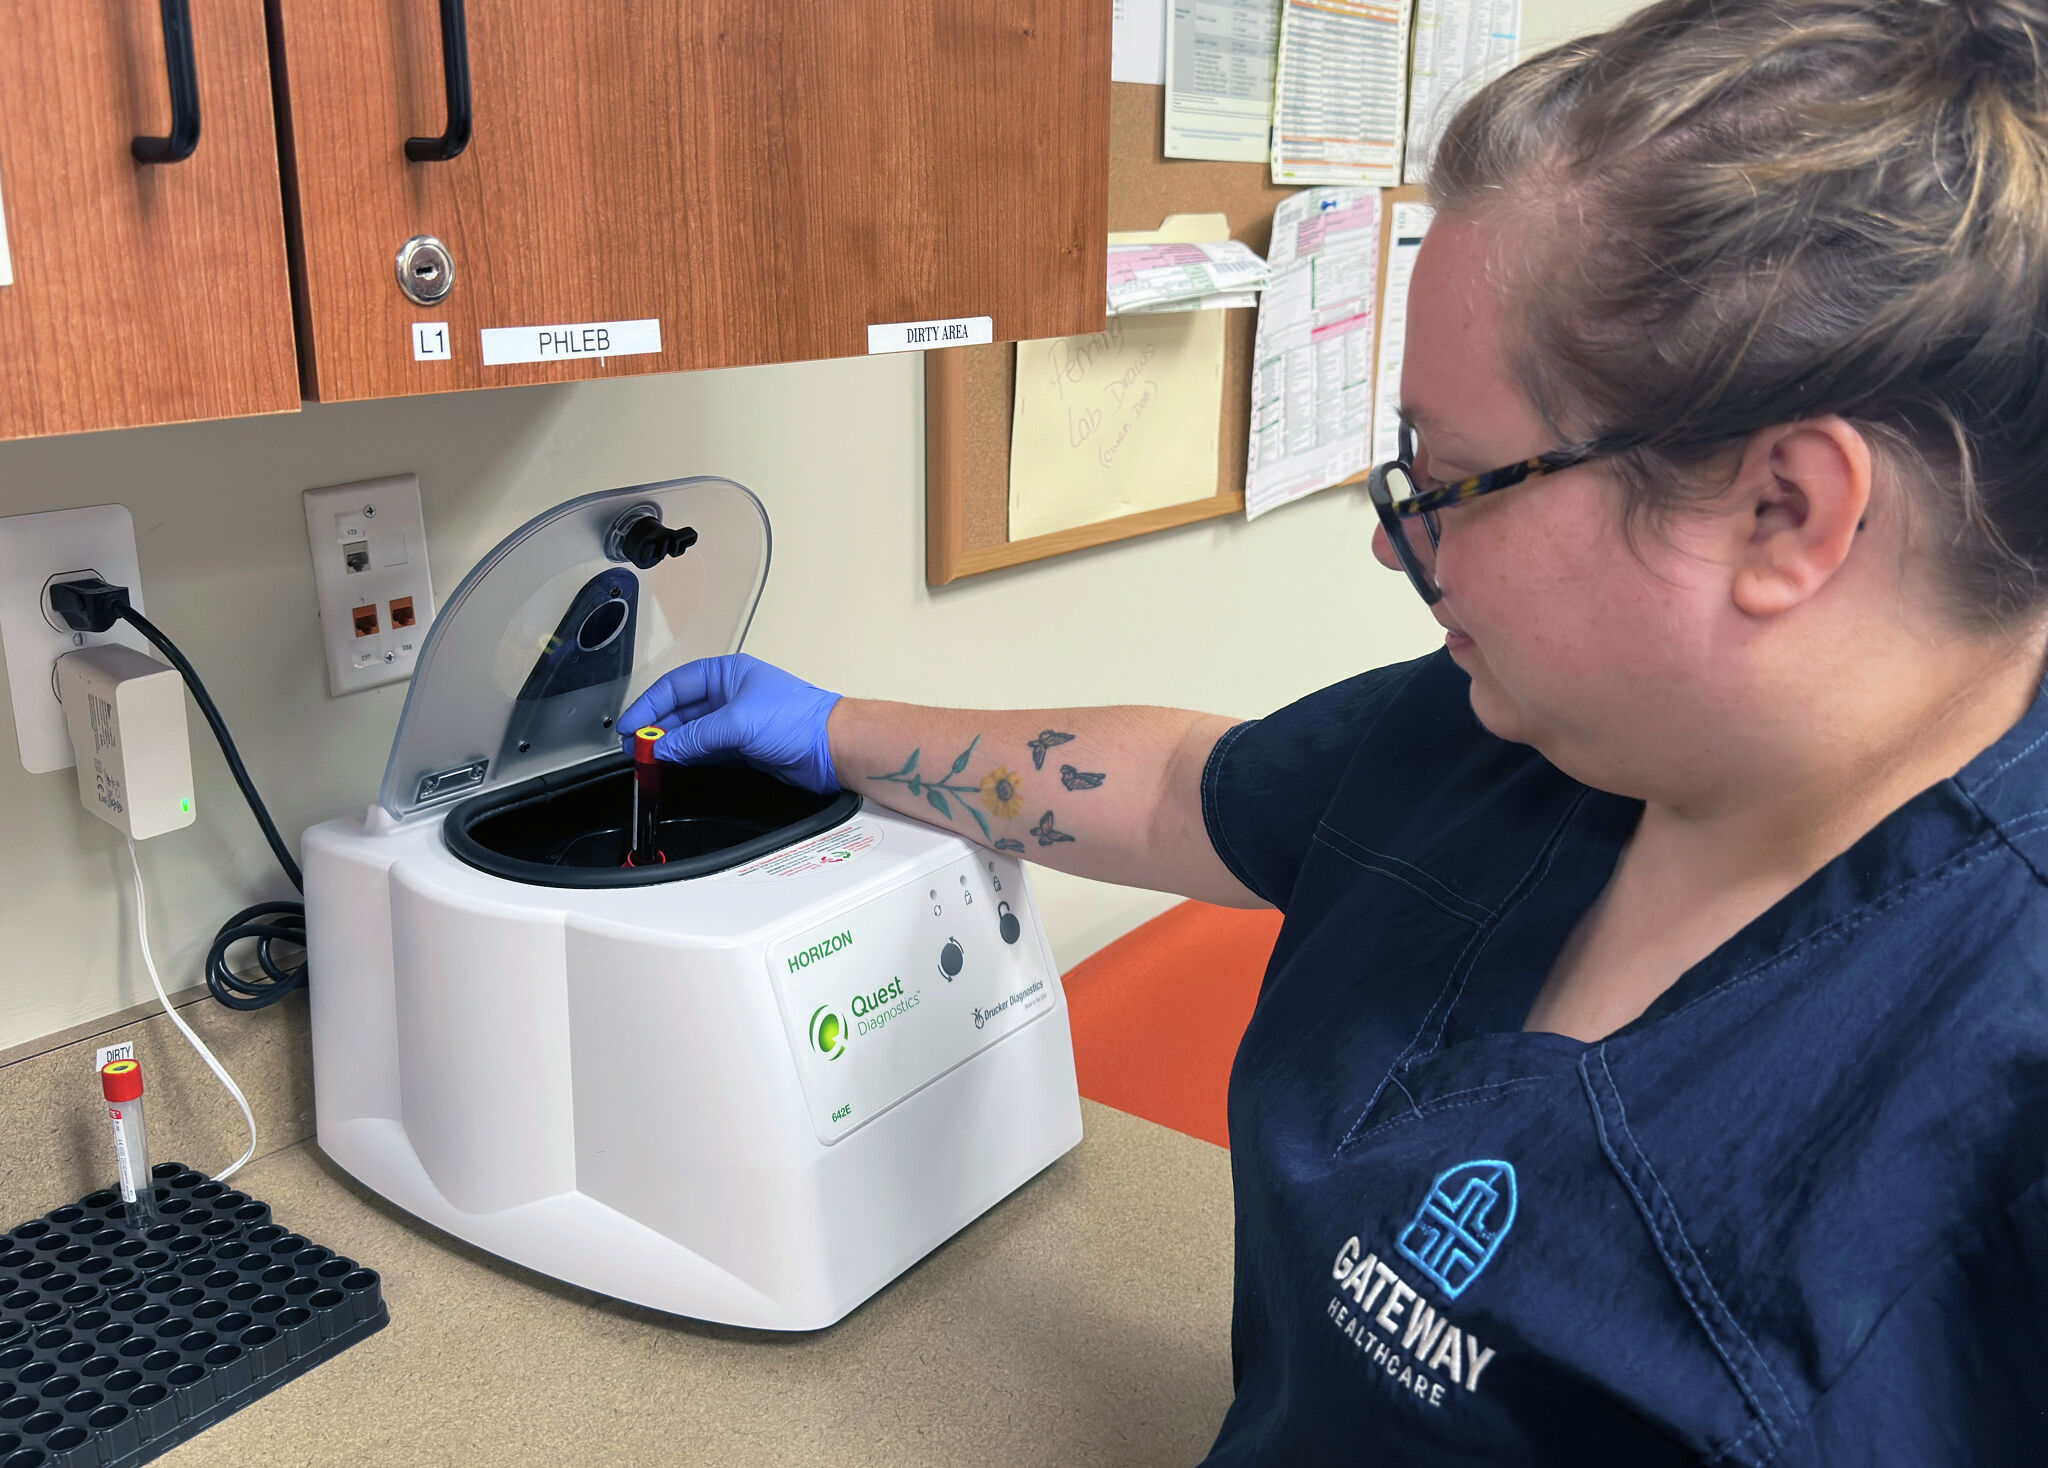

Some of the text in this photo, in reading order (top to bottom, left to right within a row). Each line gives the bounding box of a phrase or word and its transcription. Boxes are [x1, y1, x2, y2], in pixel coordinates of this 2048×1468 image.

[420, 329, 444, 353] L1
[539, 328, 611, 355] PHLEB
[906, 324, 969, 343] DIRTY AREA
[1068, 405, 1102, 448] Lab
[787, 929, 853, 974] HORIZON
[851, 976, 904, 1018] Quest
[857, 994, 920, 1036] Diagnostics
[984, 980, 1044, 1021] Drucker Diagnostics
[106, 1045, 131, 1063] DIRTY
[831, 1103, 852, 1123] 642E
[1332, 1235, 1496, 1393] GATEWAY
[1327, 1296, 1446, 1408] HEALTHCARE
